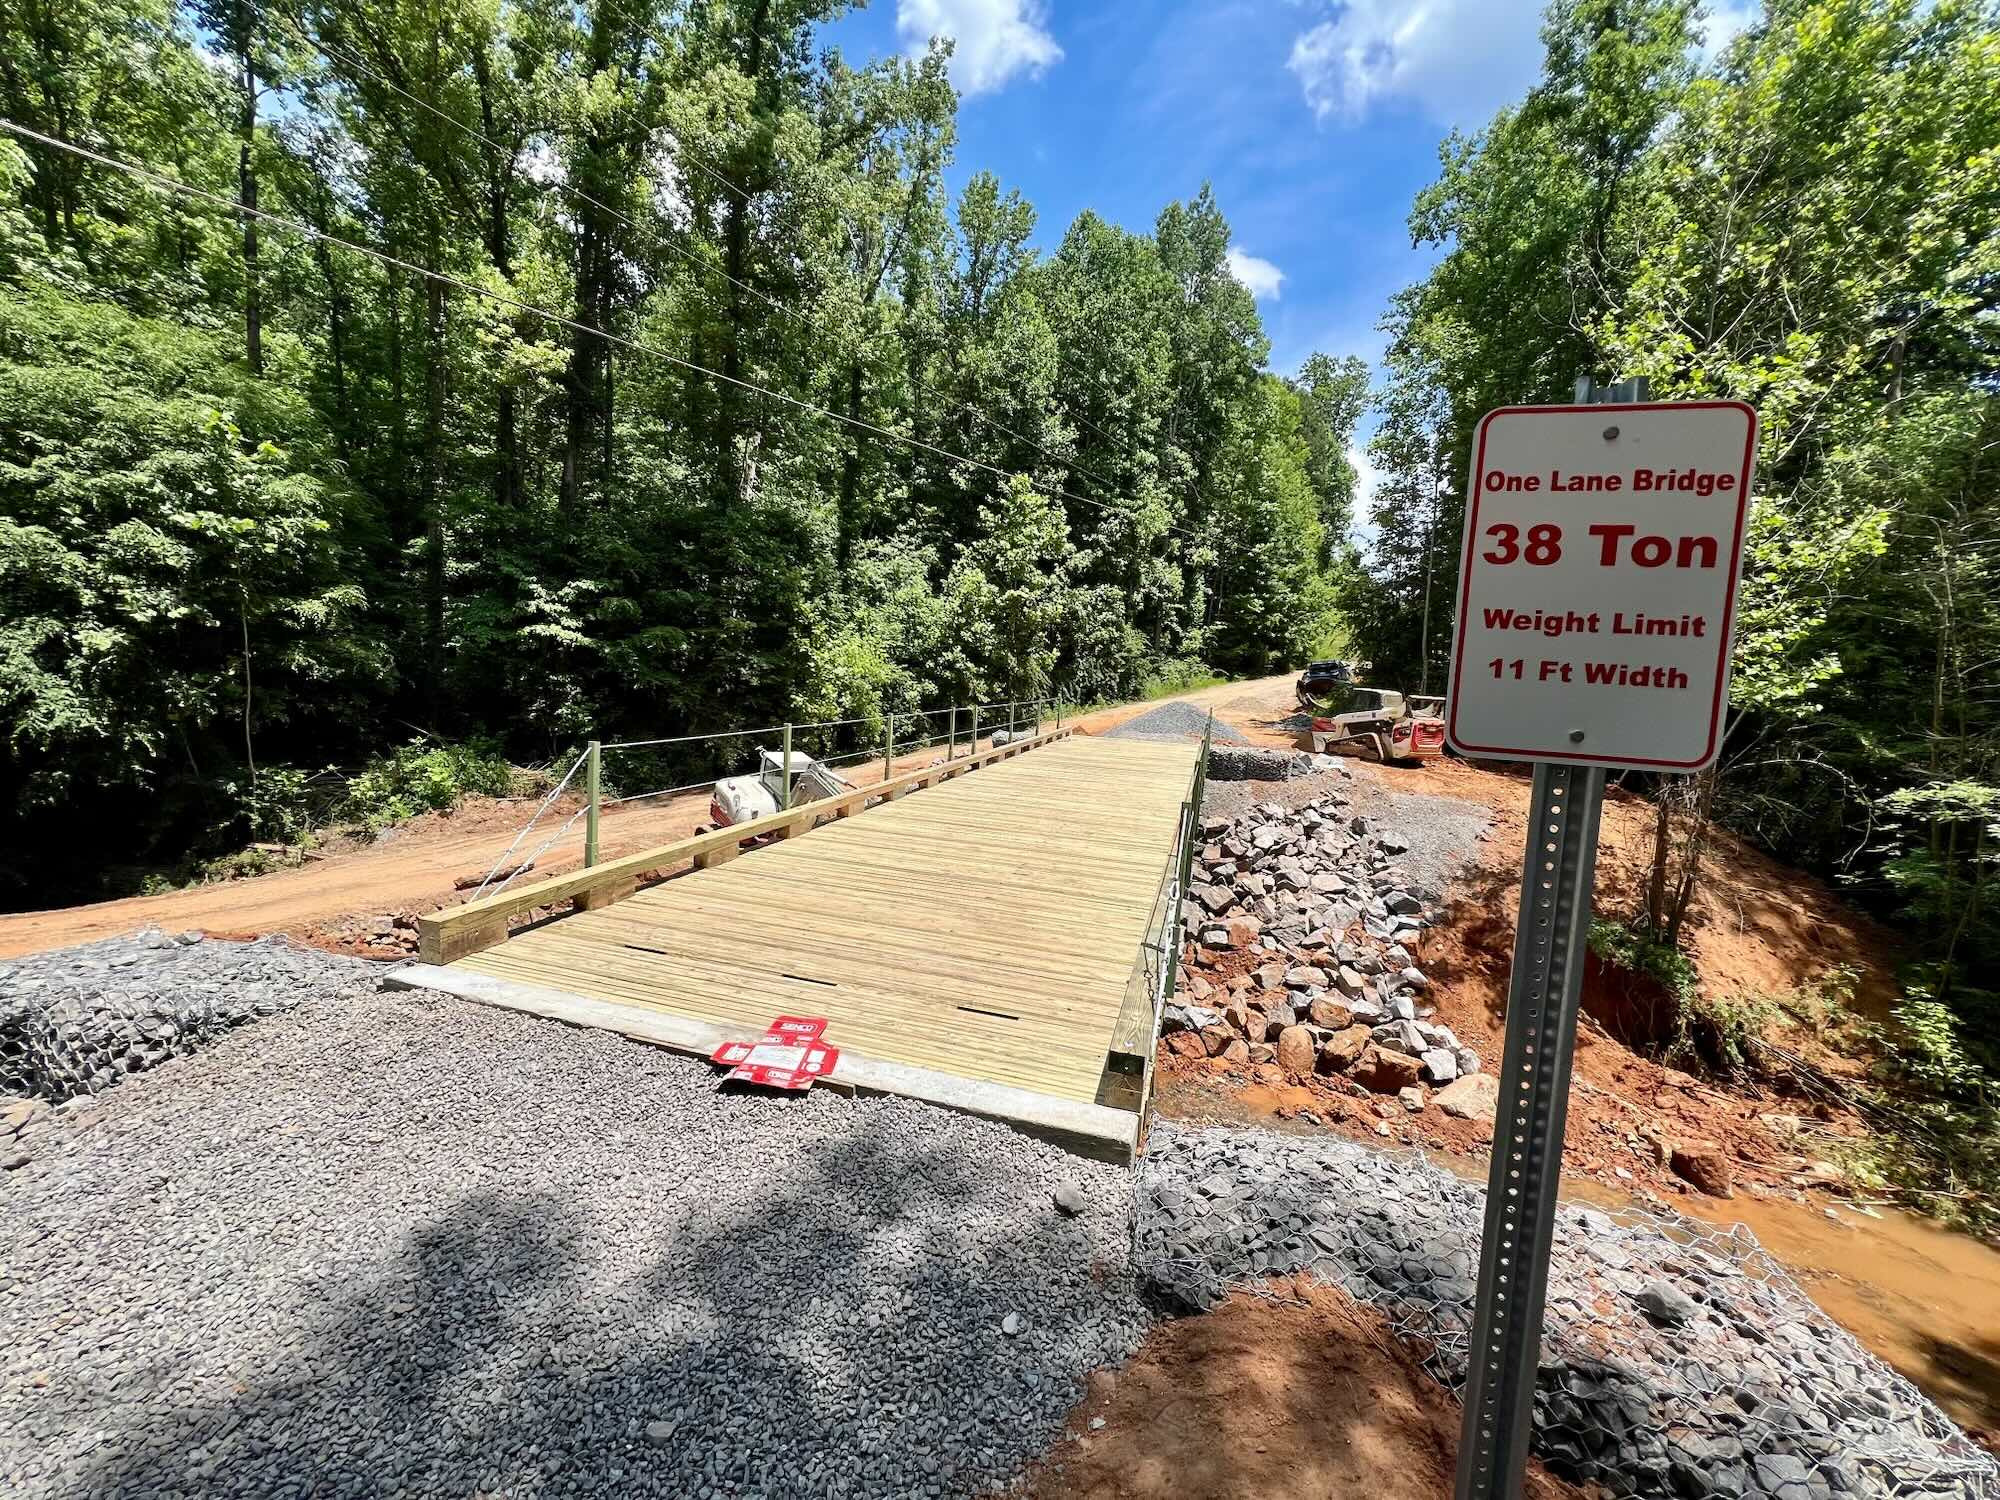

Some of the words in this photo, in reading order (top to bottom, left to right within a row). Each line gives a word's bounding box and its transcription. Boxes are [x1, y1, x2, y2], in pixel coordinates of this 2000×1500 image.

[1485, 471, 1540, 492] One
[1550, 470, 1622, 492] Lane
[1633, 469, 1736, 497] Bridge
[1483, 522, 1563, 566] 38
[1588, 523, 1719, 569] Ton
[1483, 608, 1600, 637] Weight
[1612, 612, 1706, 637] Limit
[1489, 658, 1525, 680] 11
[1538, 660, 1573, 683] Ft
[1584, 662, 1689, 689] Width
